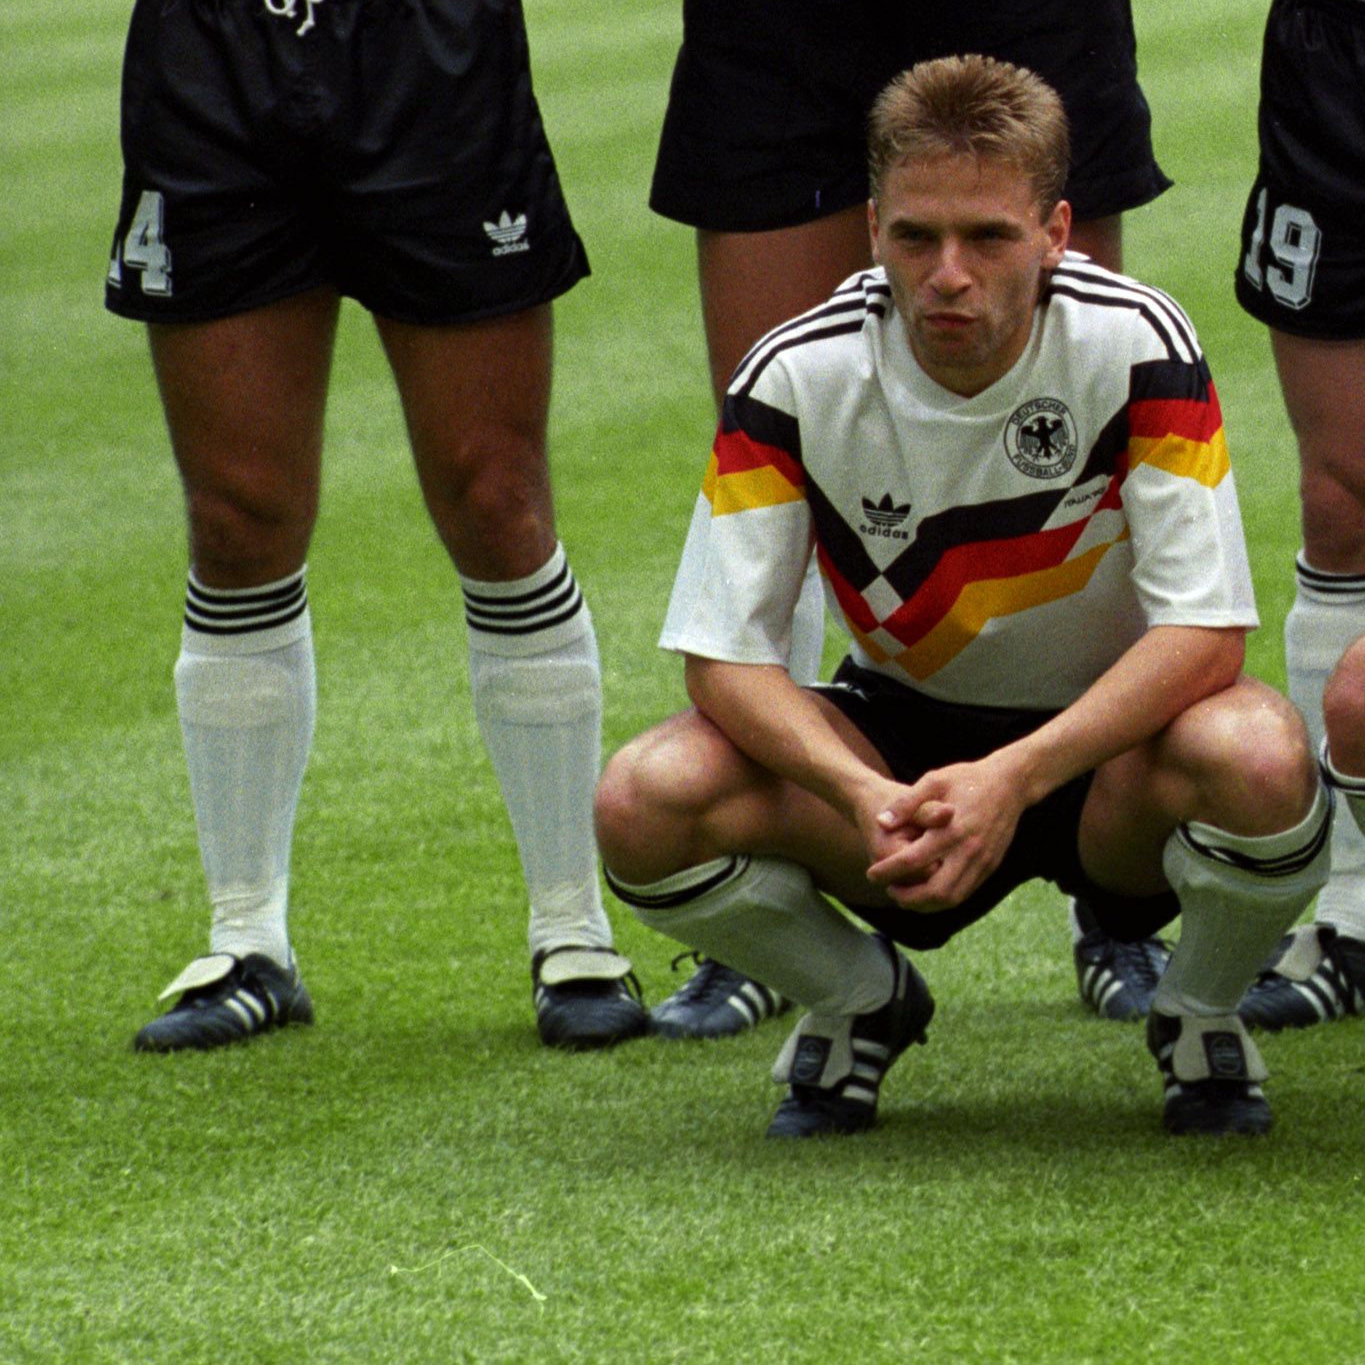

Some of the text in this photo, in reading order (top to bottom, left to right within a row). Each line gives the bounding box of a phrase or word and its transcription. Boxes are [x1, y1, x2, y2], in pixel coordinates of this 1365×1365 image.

[492, 238, 530, 256] adidas
[1244, 187, 1321, 310] 19
[1011, 399, 1067, 425] DEUTSCHER
[859, 523, 909, 540] adidas
